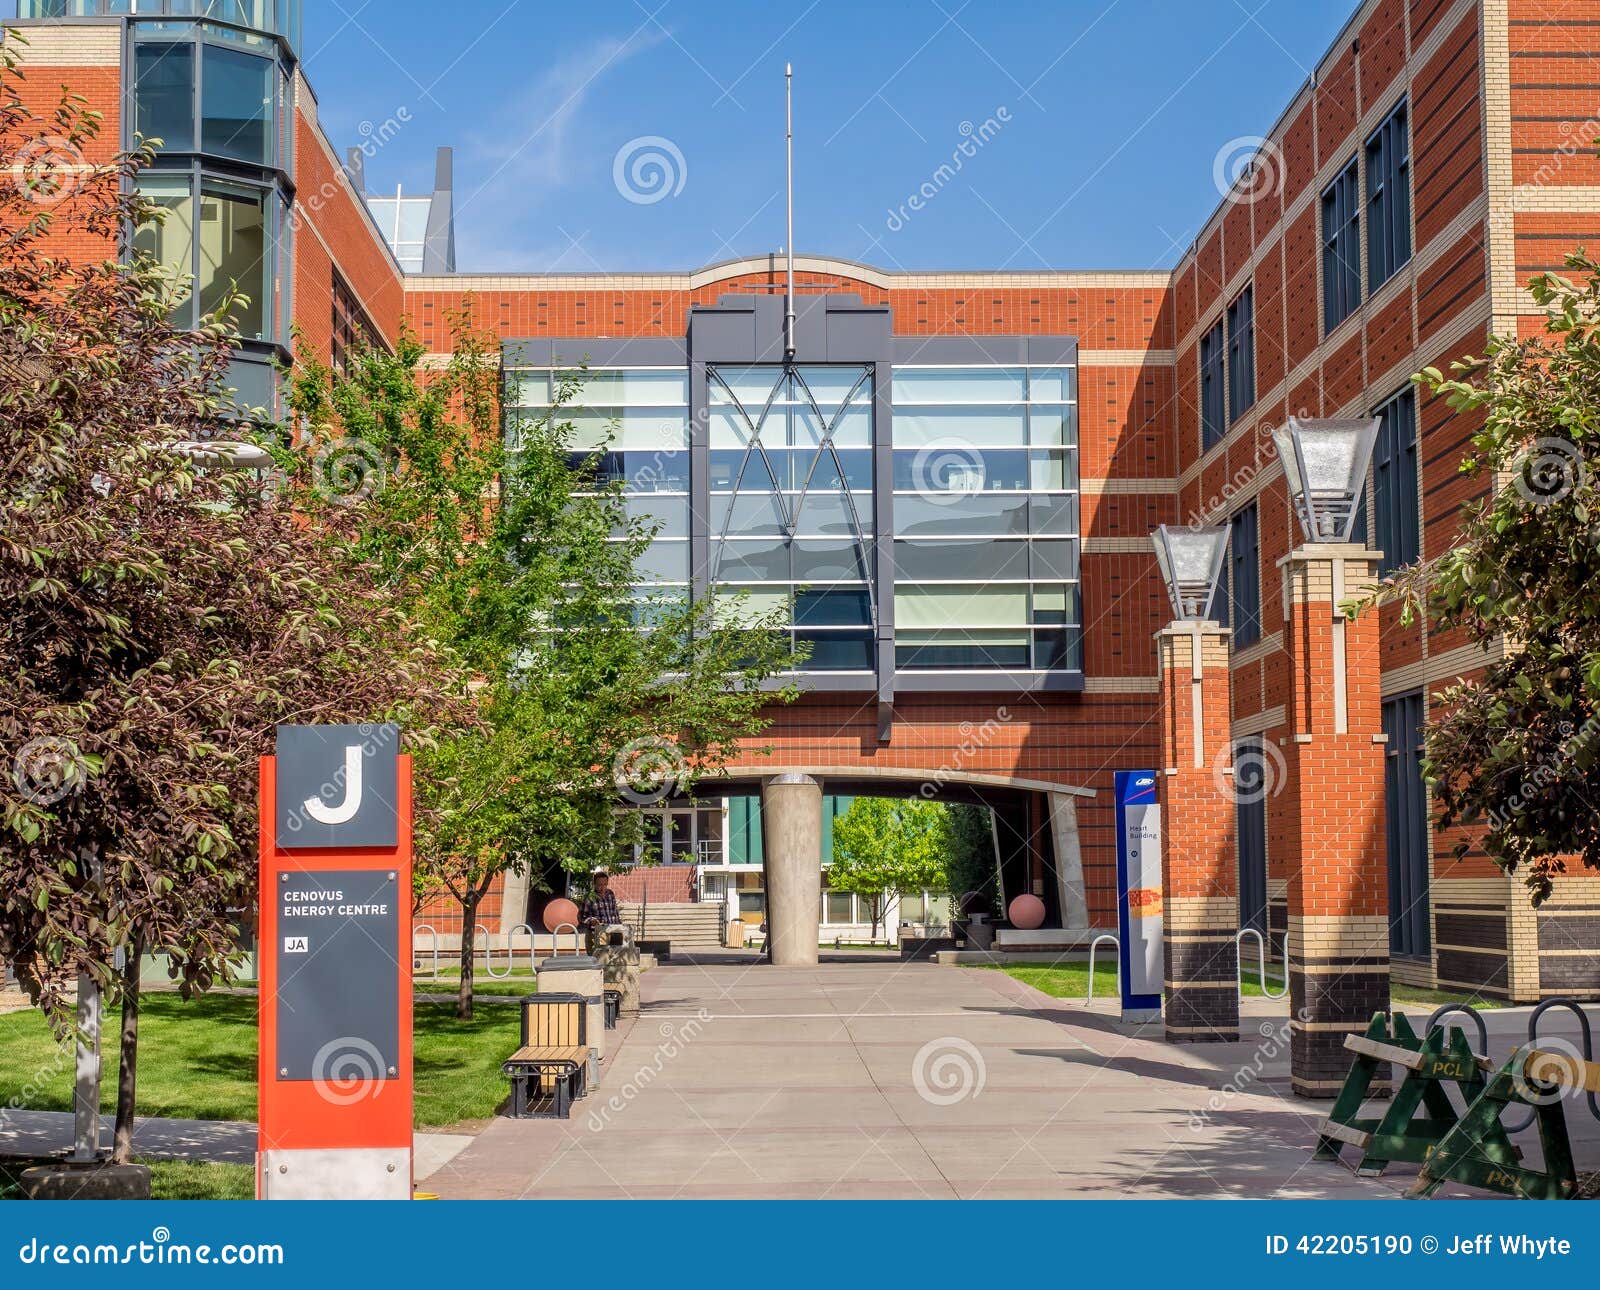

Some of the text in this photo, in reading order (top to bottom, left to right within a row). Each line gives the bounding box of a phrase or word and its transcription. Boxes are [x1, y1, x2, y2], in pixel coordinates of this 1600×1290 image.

[303, 745, 362, 824] J
[283, 890, 344, 902] CENOVUS
[284, 905, 335, 917] ENERGY
[338, 904, 388, 915] CENTRE
[287, 939, 306, 950] JA
[1432, 1061, 1465, 1077] PCL
